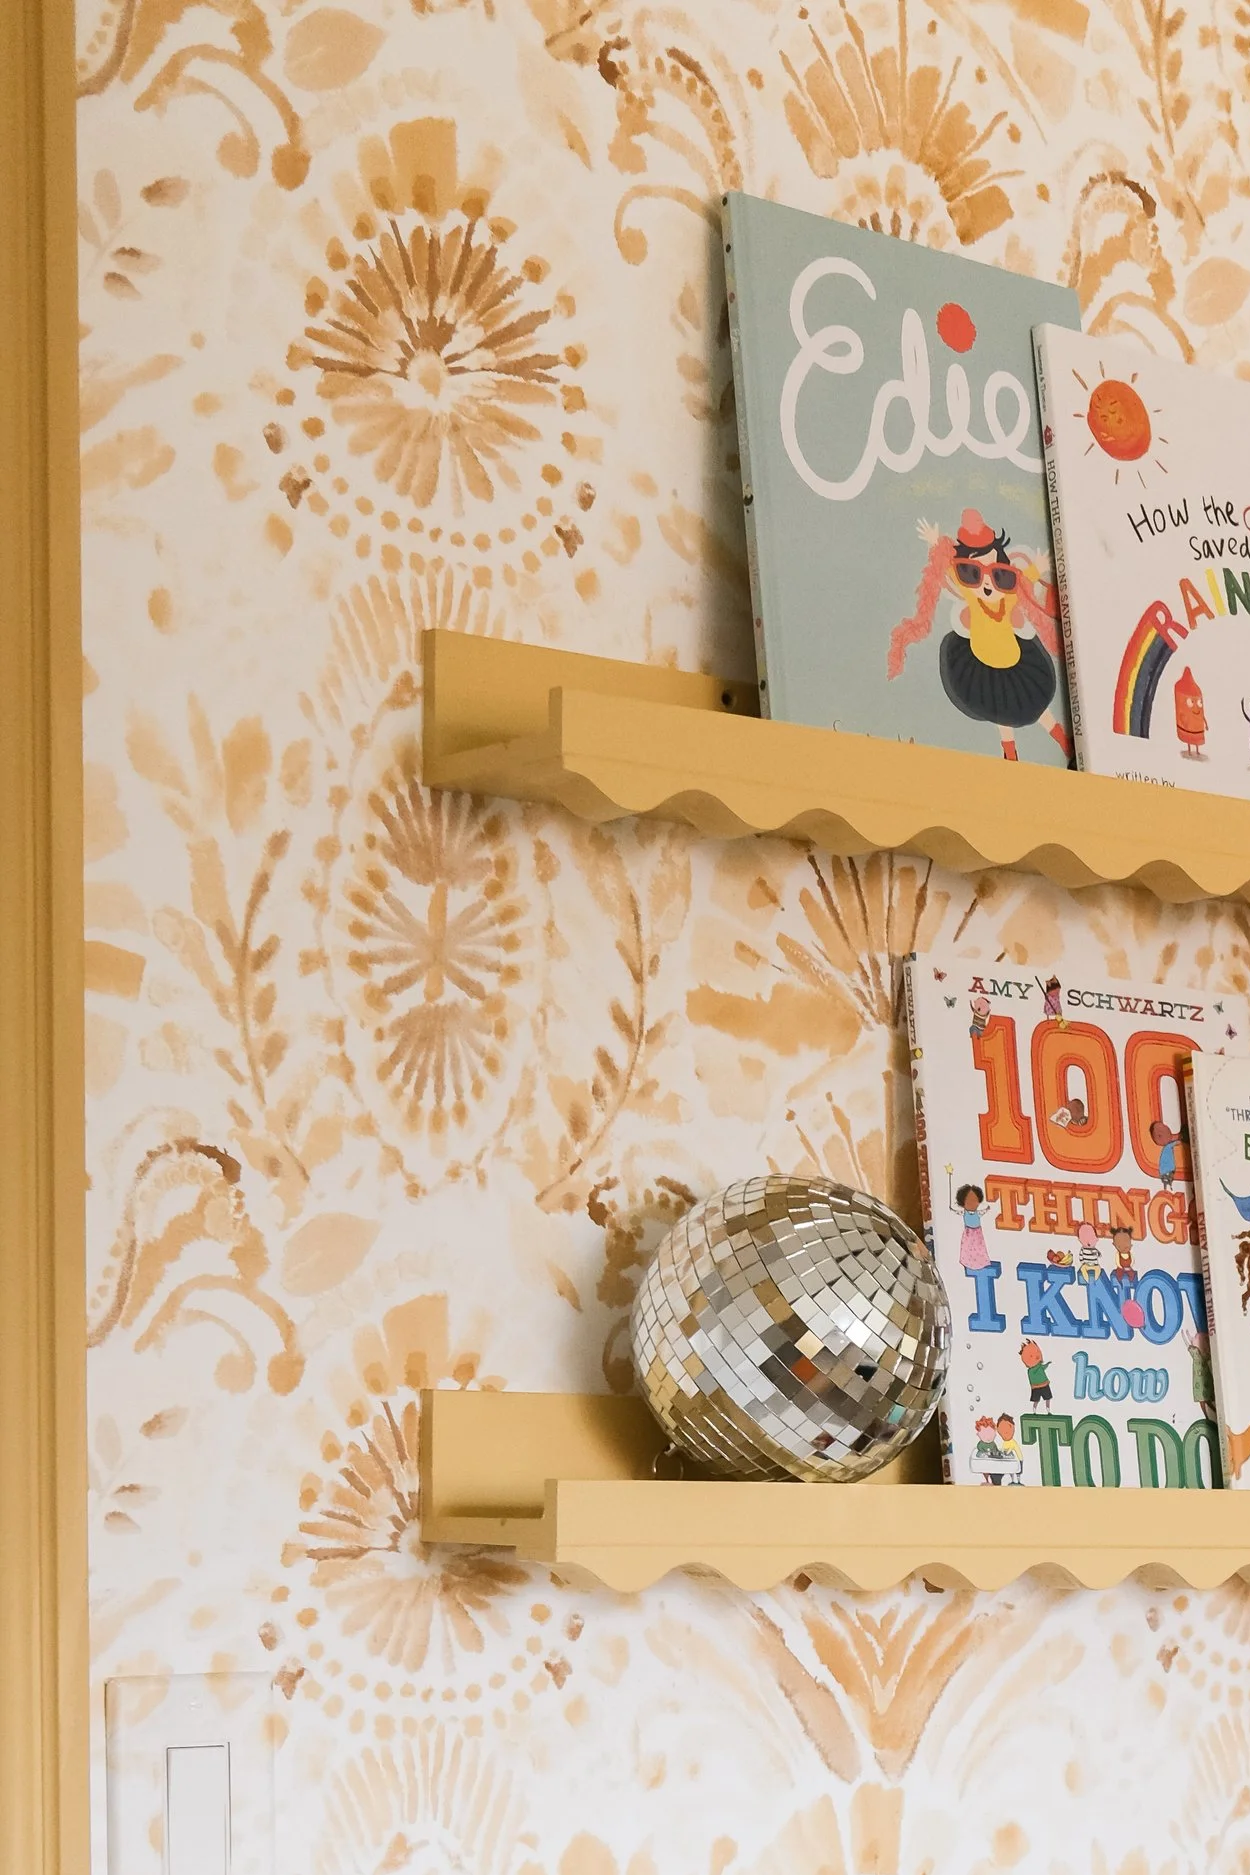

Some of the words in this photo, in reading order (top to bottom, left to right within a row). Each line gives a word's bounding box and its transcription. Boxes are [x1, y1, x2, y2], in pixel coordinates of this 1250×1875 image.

[780, 256, 1046, 501] Edie
[1047, 460, 1058, 493] HOW
[1051, 499, 1061, 526] THE
[1127, 498, 1190, 543] How
[1202, 496, 1239, 527] the
[1054, 527, 1068, 592] CRAYONS
[1061, 594, 1072, 638] SAVED
[1065, 640, 1076, 670] THE
[1069, 671, 1083, 737] RAINBOW
[905, 966, 916, 1045] SCHWARTZ
[967, 976, 1033, 1000] AMY
[1067, 988, 1205, 1022] SCHWARTZ
[971, 1013, 1203, 1183] 100
[965, 1261, 1007, 1333] I
[1198, 1212, 1208, 1250] EVERY
[1206, 1298, 1217, 1337] THING
[1072, 1350, 1168, 1403] how
[1020, 1414, 1121, 1487] TO
[1127, 1418, 1224, 1489] DO
